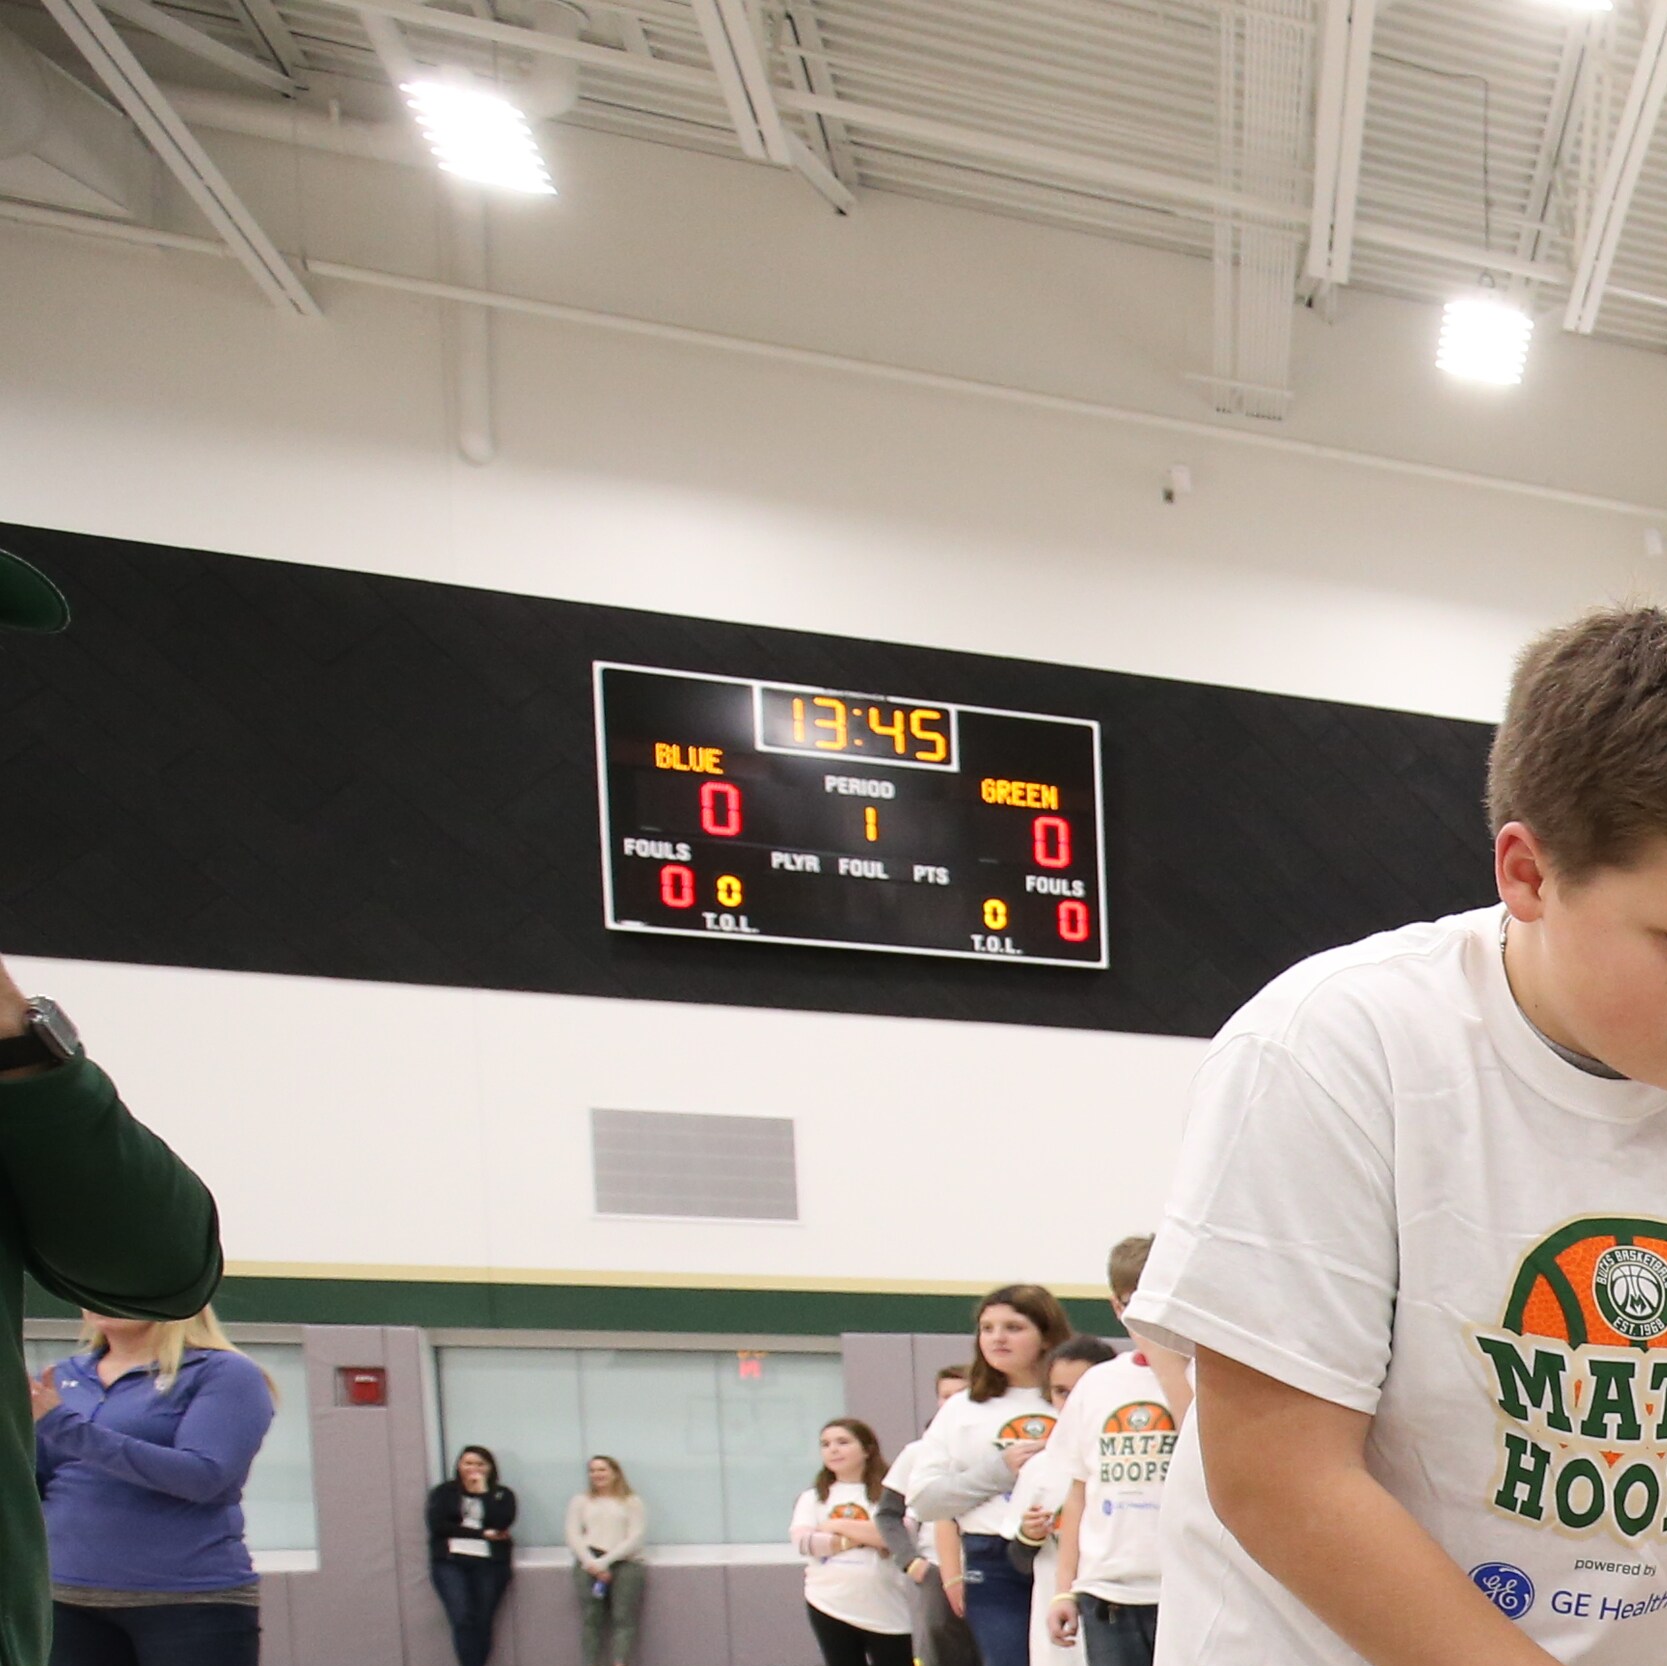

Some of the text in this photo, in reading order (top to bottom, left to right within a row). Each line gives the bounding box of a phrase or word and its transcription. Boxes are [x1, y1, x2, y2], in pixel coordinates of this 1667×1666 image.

[792, 697, 947, 762] 13:45
[654, 743, 723, 775] BLUE
[825, 775, 895, 799] PERIOD
[980, 778, 1059, 810] GREEN
[700, 782, 742, 836] 0
[863, 807, 877, 842] 1
[623, 838, 692, 861] FOULS
[1032, 816, 1070, 869] 0
[771, 851, 820, 875] PLYR
[838, 857, 889, 880] FOUL
[661, 865, 695, 909] 0
[913, 865, 950, 886] PTS
[1025, 875, 1085, 897] FOULS
[715, 875, 743, 908] 0
[701, 912, 760, 934] T.O.L.
[983, 899, 1008, 931] 0
[1057, 900, 1090, 943] 0
[970, 934, 1023, 956] T.O.L.
[1639, 1318, 1666, 1337] 1968
[1100, 1434, 1179, 1456] MATH
[1101, 1461, 1170, 1482] HOOPS
[1574, 1558, 1657, 1577] powered by
[1551, 1590, 1592, 1617] GE
